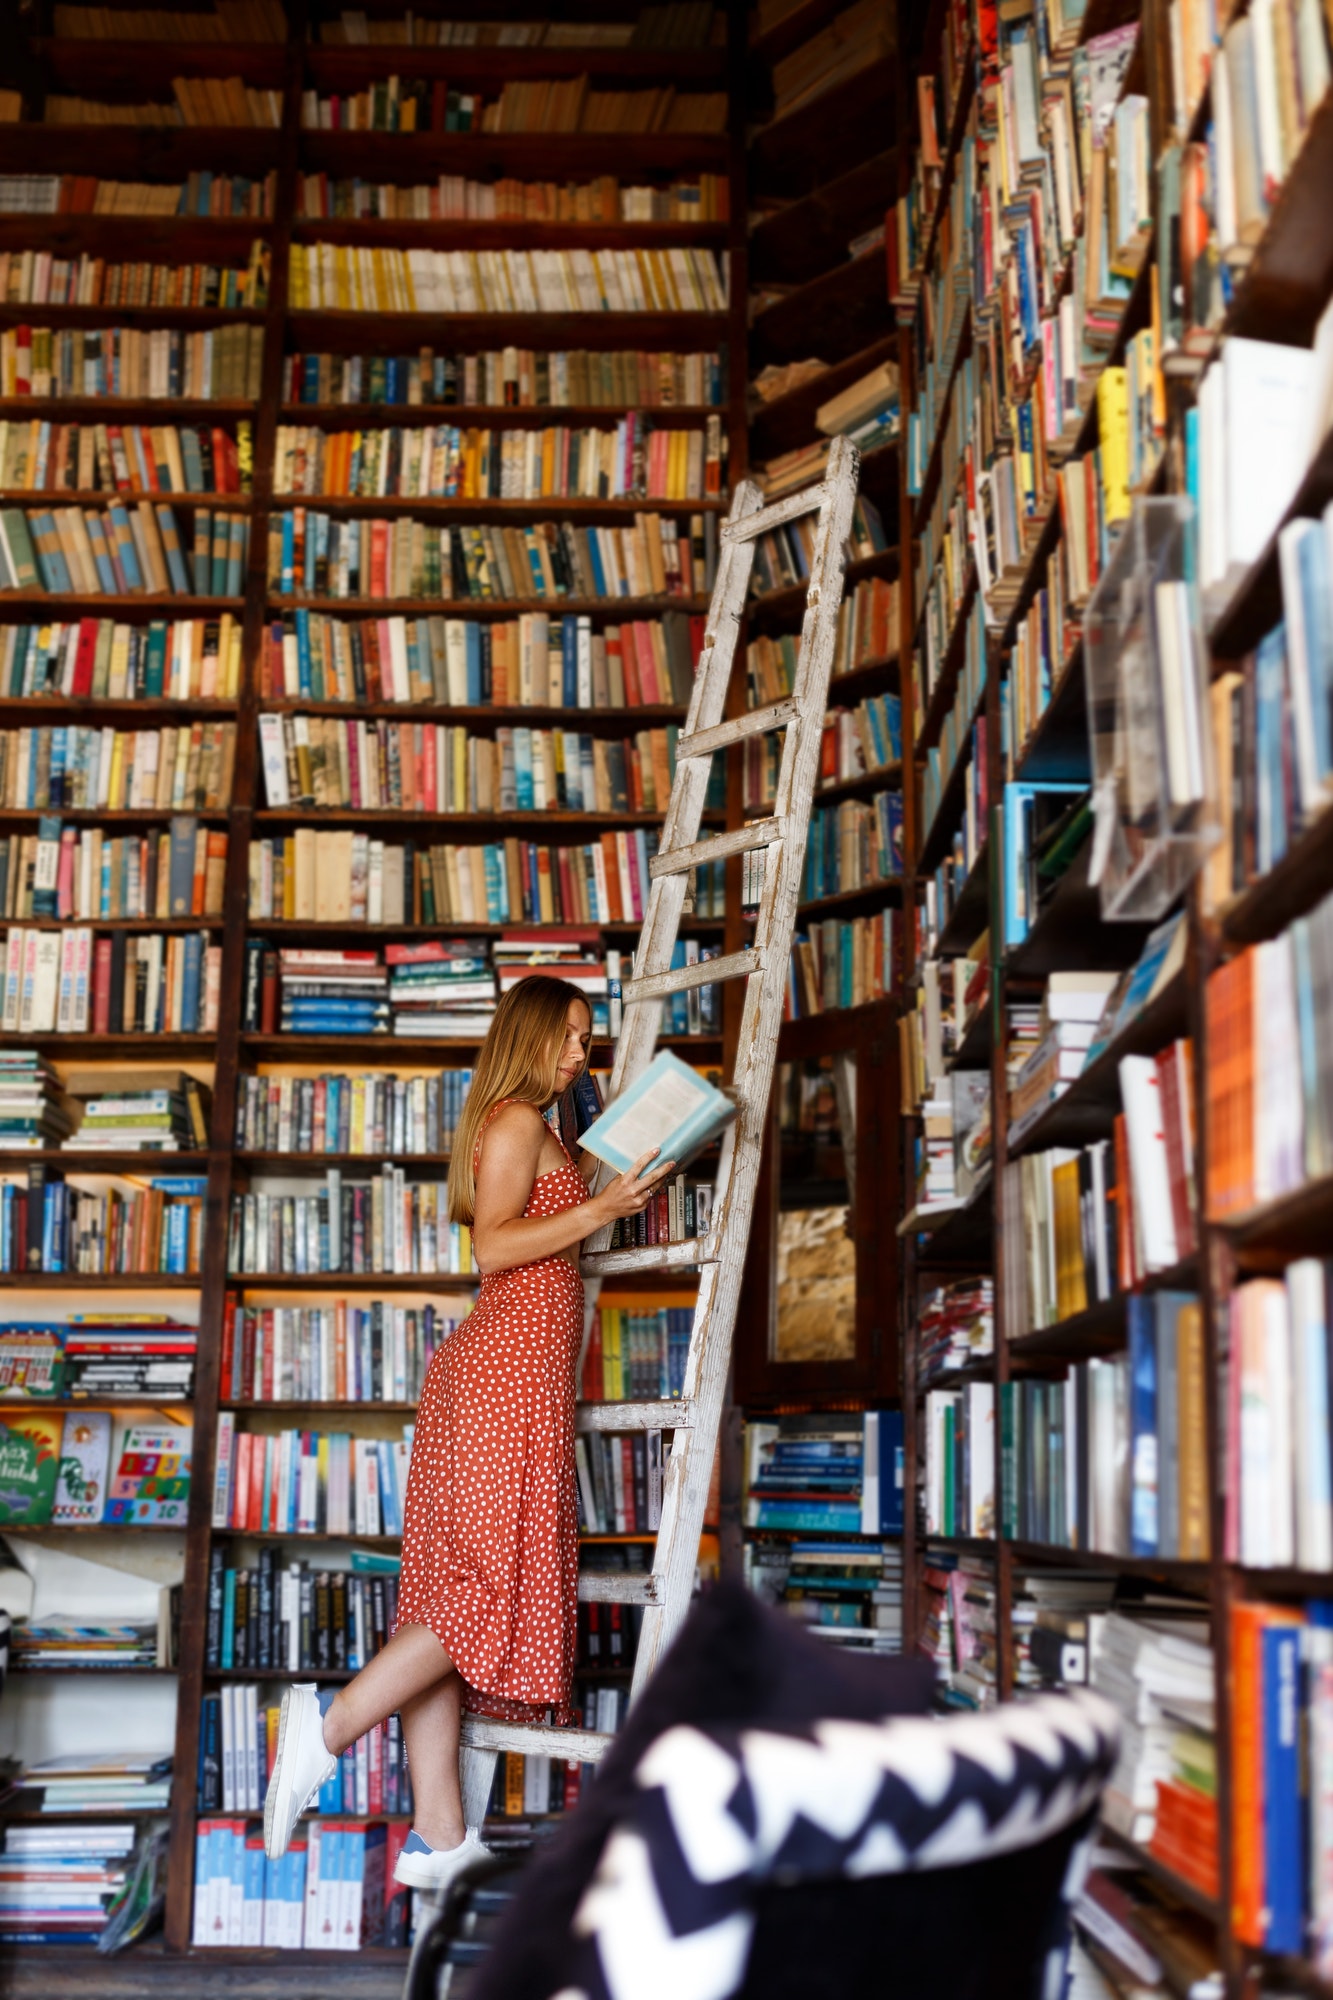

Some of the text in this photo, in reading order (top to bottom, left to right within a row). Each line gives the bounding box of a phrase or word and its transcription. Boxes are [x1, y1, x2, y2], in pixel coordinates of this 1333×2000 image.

[72, 1382, 98, 1391] BOND
[113, 1382, 140, 1391] BOND
[126, 1456, 175, 1472] 1 2 3
[119, 1479, 182, 1496] 5 6 7
[112, 1502, 179, 1518] 8 9 10
[795, 1513, 840, 1528] ATLAS
